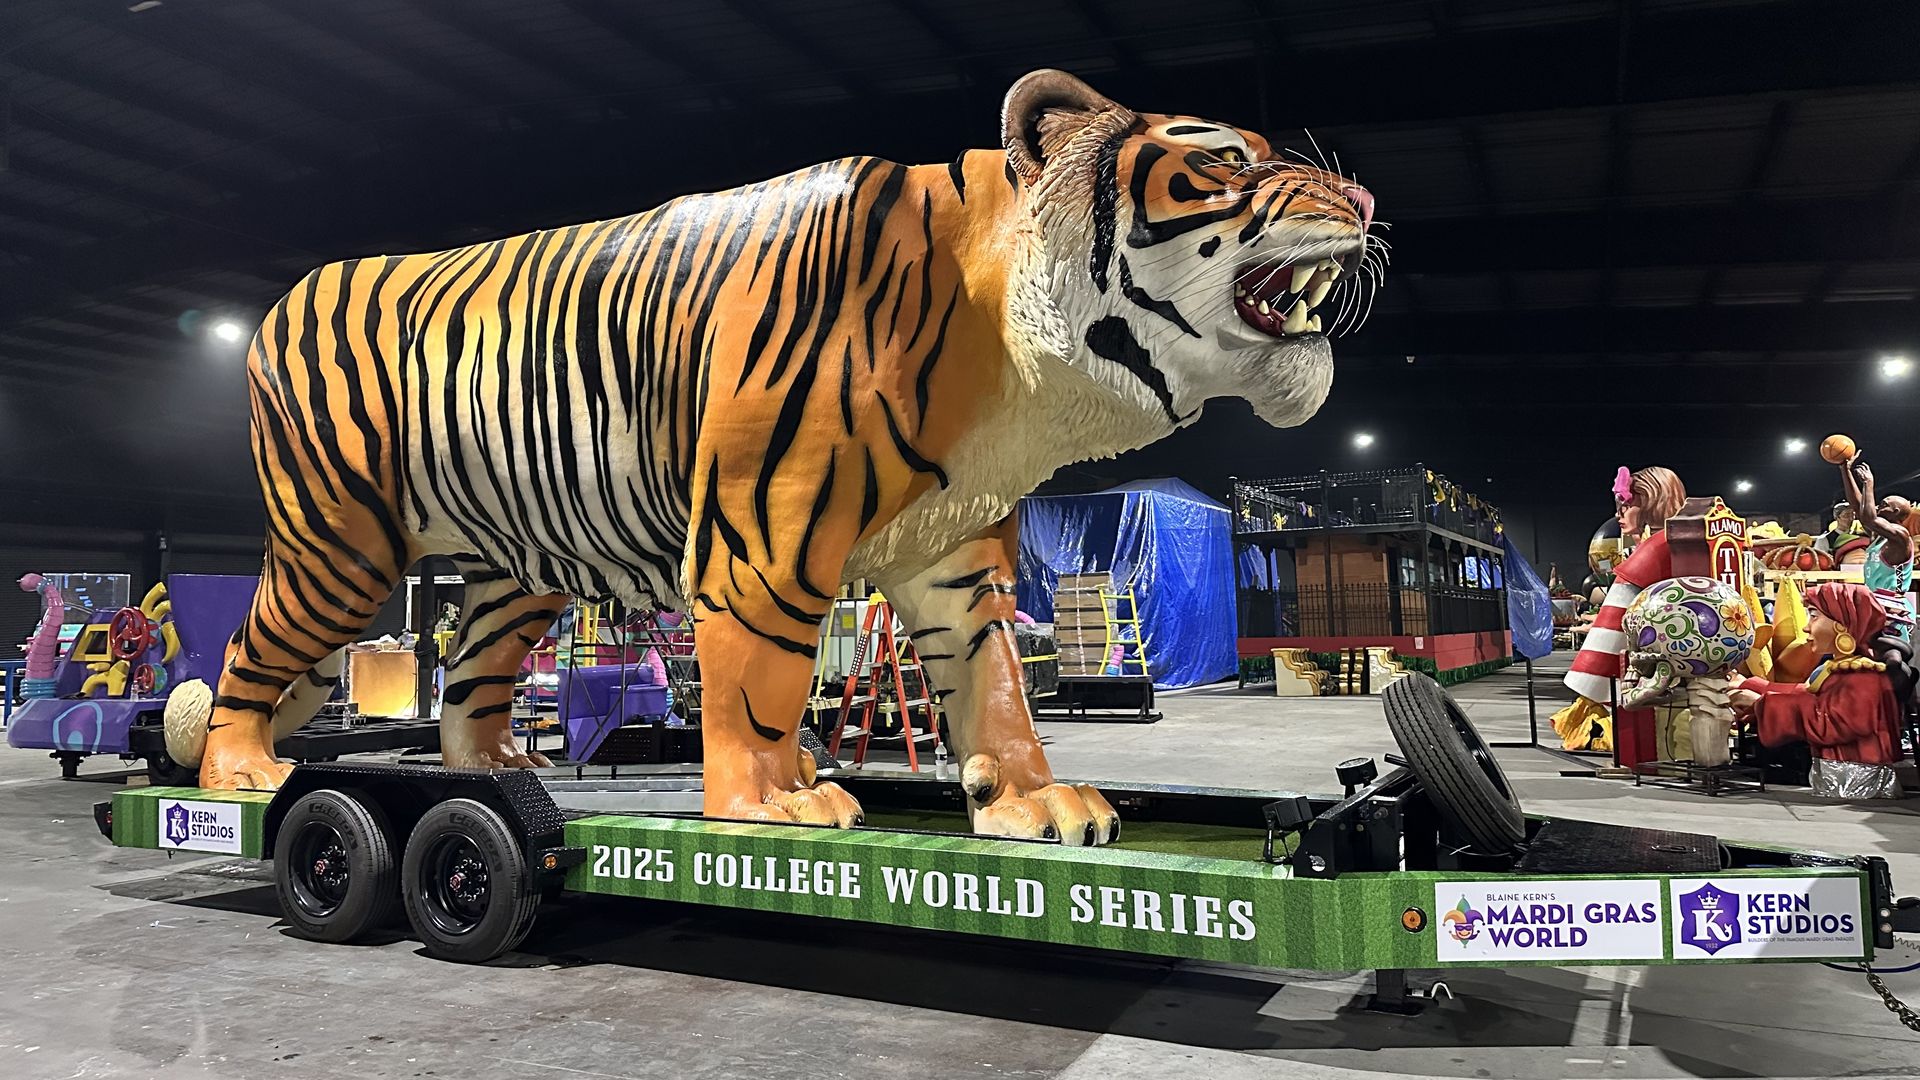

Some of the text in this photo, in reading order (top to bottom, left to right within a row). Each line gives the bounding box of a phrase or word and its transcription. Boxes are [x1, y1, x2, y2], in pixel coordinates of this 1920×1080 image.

[1709, 518, 1741, 536] ALAMO
[191, 811, 217, 824] KERN
[191, 823, 234, 839] STUDIOS
[593, 844, 1256, 941] 2025 COLLEGE WORLD SERIES
[1486, 892, 1556, 902] BLAINE KERN'S
[1747, 893, 1811, 913] KERN
[1486, 902, 1657, 925] MARDI GRAS
[1747, 914, 1855, 935] STUDIOS
[1487, 927, 1588, 948] WORLD
